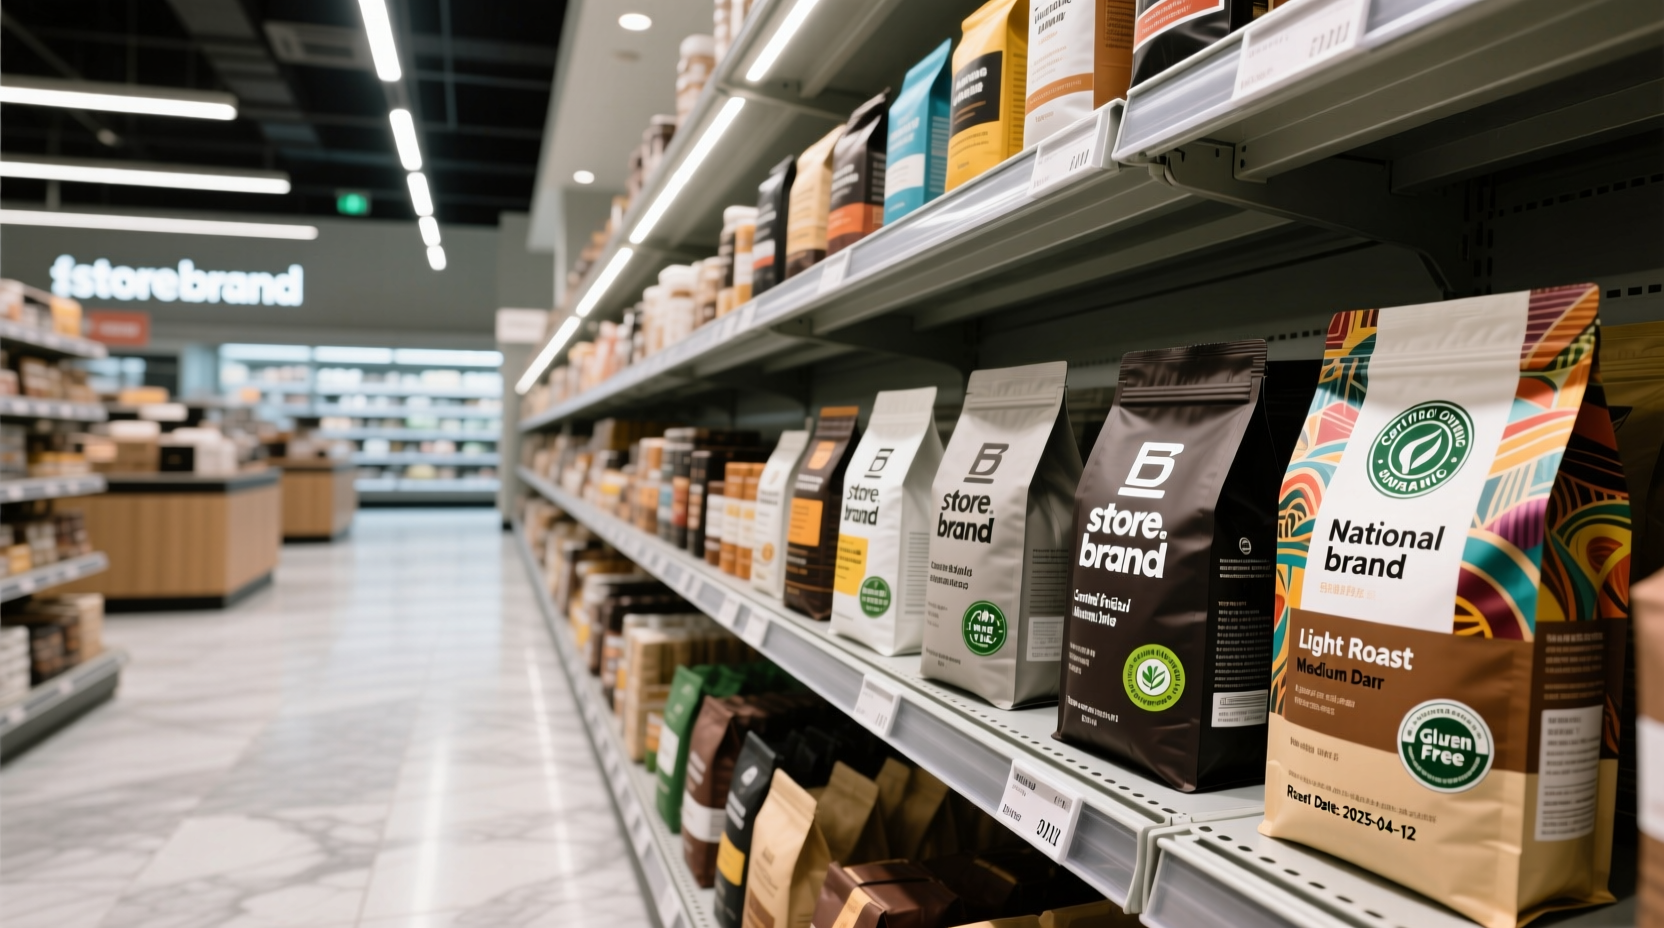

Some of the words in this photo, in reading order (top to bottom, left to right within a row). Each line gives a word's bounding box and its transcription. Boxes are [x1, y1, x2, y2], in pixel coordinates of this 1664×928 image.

[936, 512, 995, 544] brand
[1328, 518, 1446, 551] National
[1078, 532, 1168, 579] brand
[1324, 545, 1407, 579] brand
[1298, 627, 1345, 657] Light
[1347, 637, 1415, 671] Roast
[1420, 744, 1465, 767] Free
[1342, 805, 1417, 841] 2025-04-12
